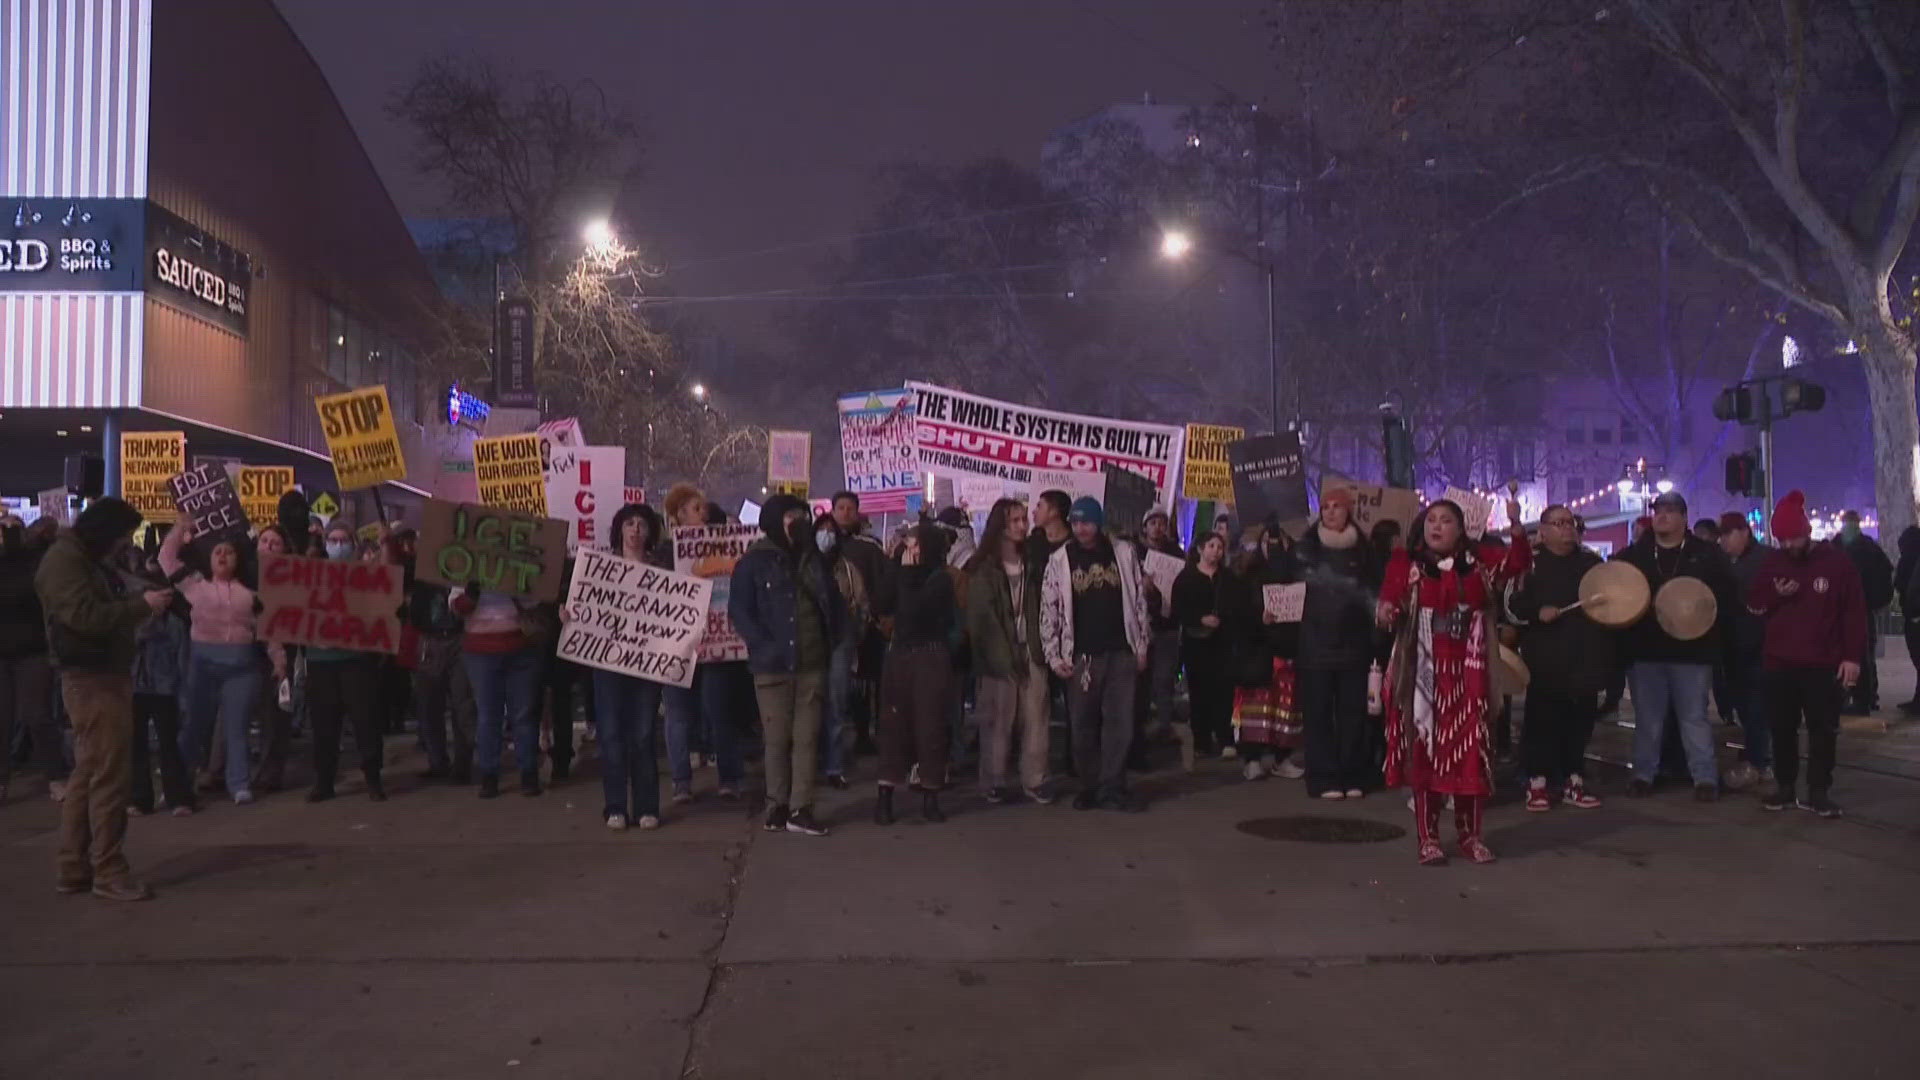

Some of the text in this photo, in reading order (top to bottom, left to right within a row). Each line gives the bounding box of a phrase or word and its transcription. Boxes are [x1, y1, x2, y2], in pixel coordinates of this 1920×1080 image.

[61, 239, 110, 253] BBQ &
[61, 255, 110, 273] Spirits
[157, 248, 225, 306] SAUCED
[321, 394, 384, 438] STOP
[916, 389, 1171, 461] THE WHOLE SYSTEM IS GUILTY!
[125, 438, 180, 458] TRUMP &
[476, 437, 537, 463] WE WON
[918, 424, 1001, 456] SHUT
[1011, 443, 1042, 465] IT
[478, 464, 500, 481] OUR
[501, 461, 540, 478] RIGHTS
[934, 450, 951, 466] FOR
[952, 454, 997, 476] SOCIALISM
[998, 465, 1009, 478] &
[242, 470, 290, 496] STOP
[480, 480, 542, 503] WE WON'T
[193, 505, 240, 539] ICE
[455, 509, 542, 556] ICE
[677, 541, 737, 559] BECOMES
[437, 544, 542, 594] OUT
[583, 552, 702, 600] THEY BLAME
[308, 590, 348, 613] LA
[573, 581, 700, 626] IMMIGRANTS
[265, 606, 393, 650] MIGRA
[571, 604, 592, 624] SO
[596, 609, 628, 632] YOU
[635, 620, 691, 642] WON'T
[611, 630, 649, 648] NAME
